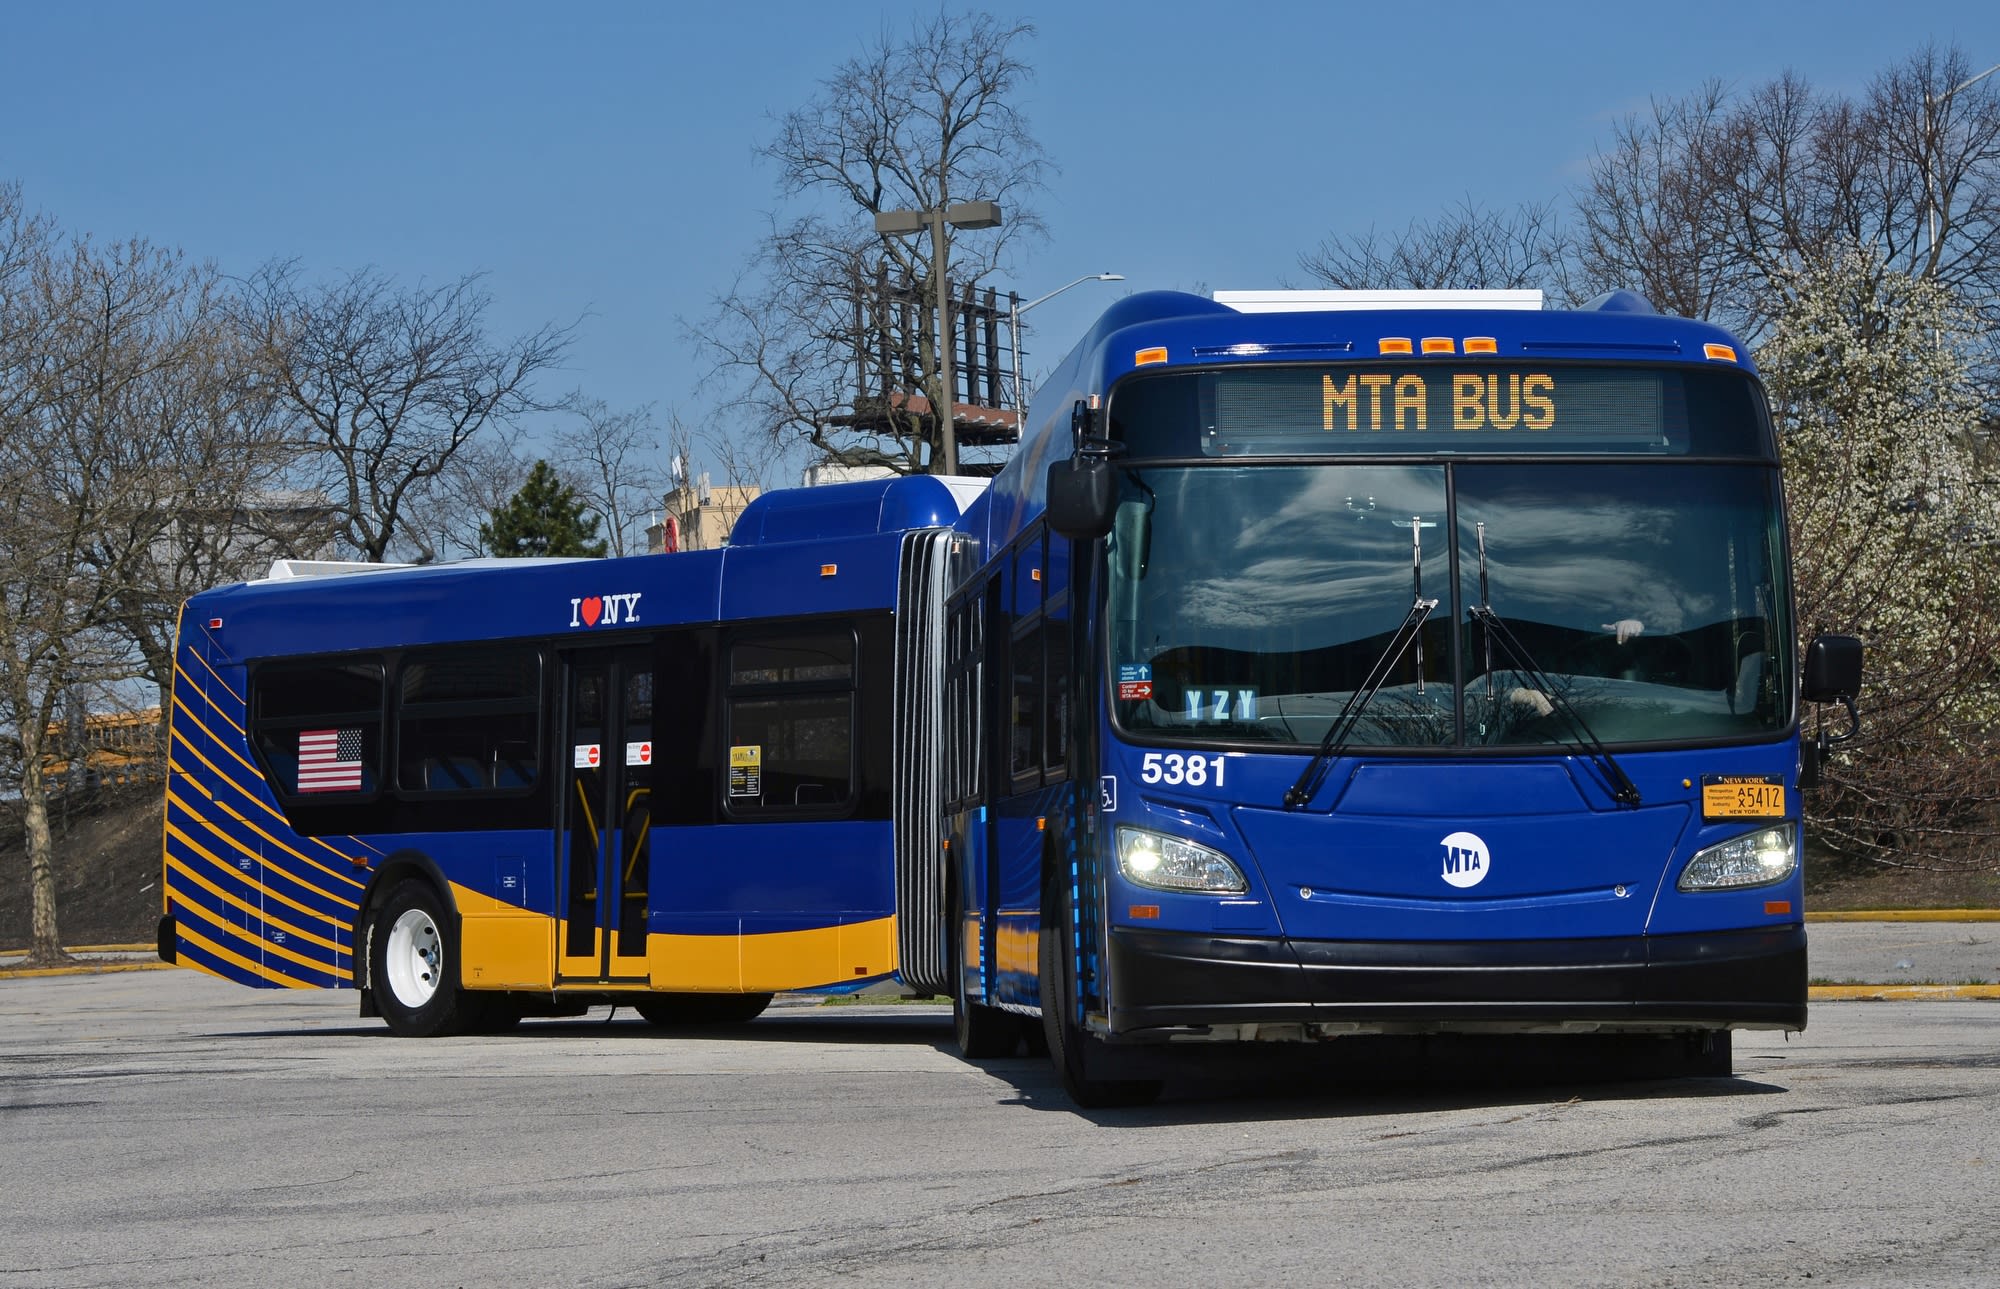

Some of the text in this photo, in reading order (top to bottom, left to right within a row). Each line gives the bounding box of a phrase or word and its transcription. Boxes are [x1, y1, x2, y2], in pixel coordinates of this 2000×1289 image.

[1323, 374, 1555, 430] MTA BUS
[570, 598, 581, 627] I
[1141, 753, 1225, 787] 5381
[1747, 787, 1780, 808] 5412
[1440, 844, 1481, 876] MTA
